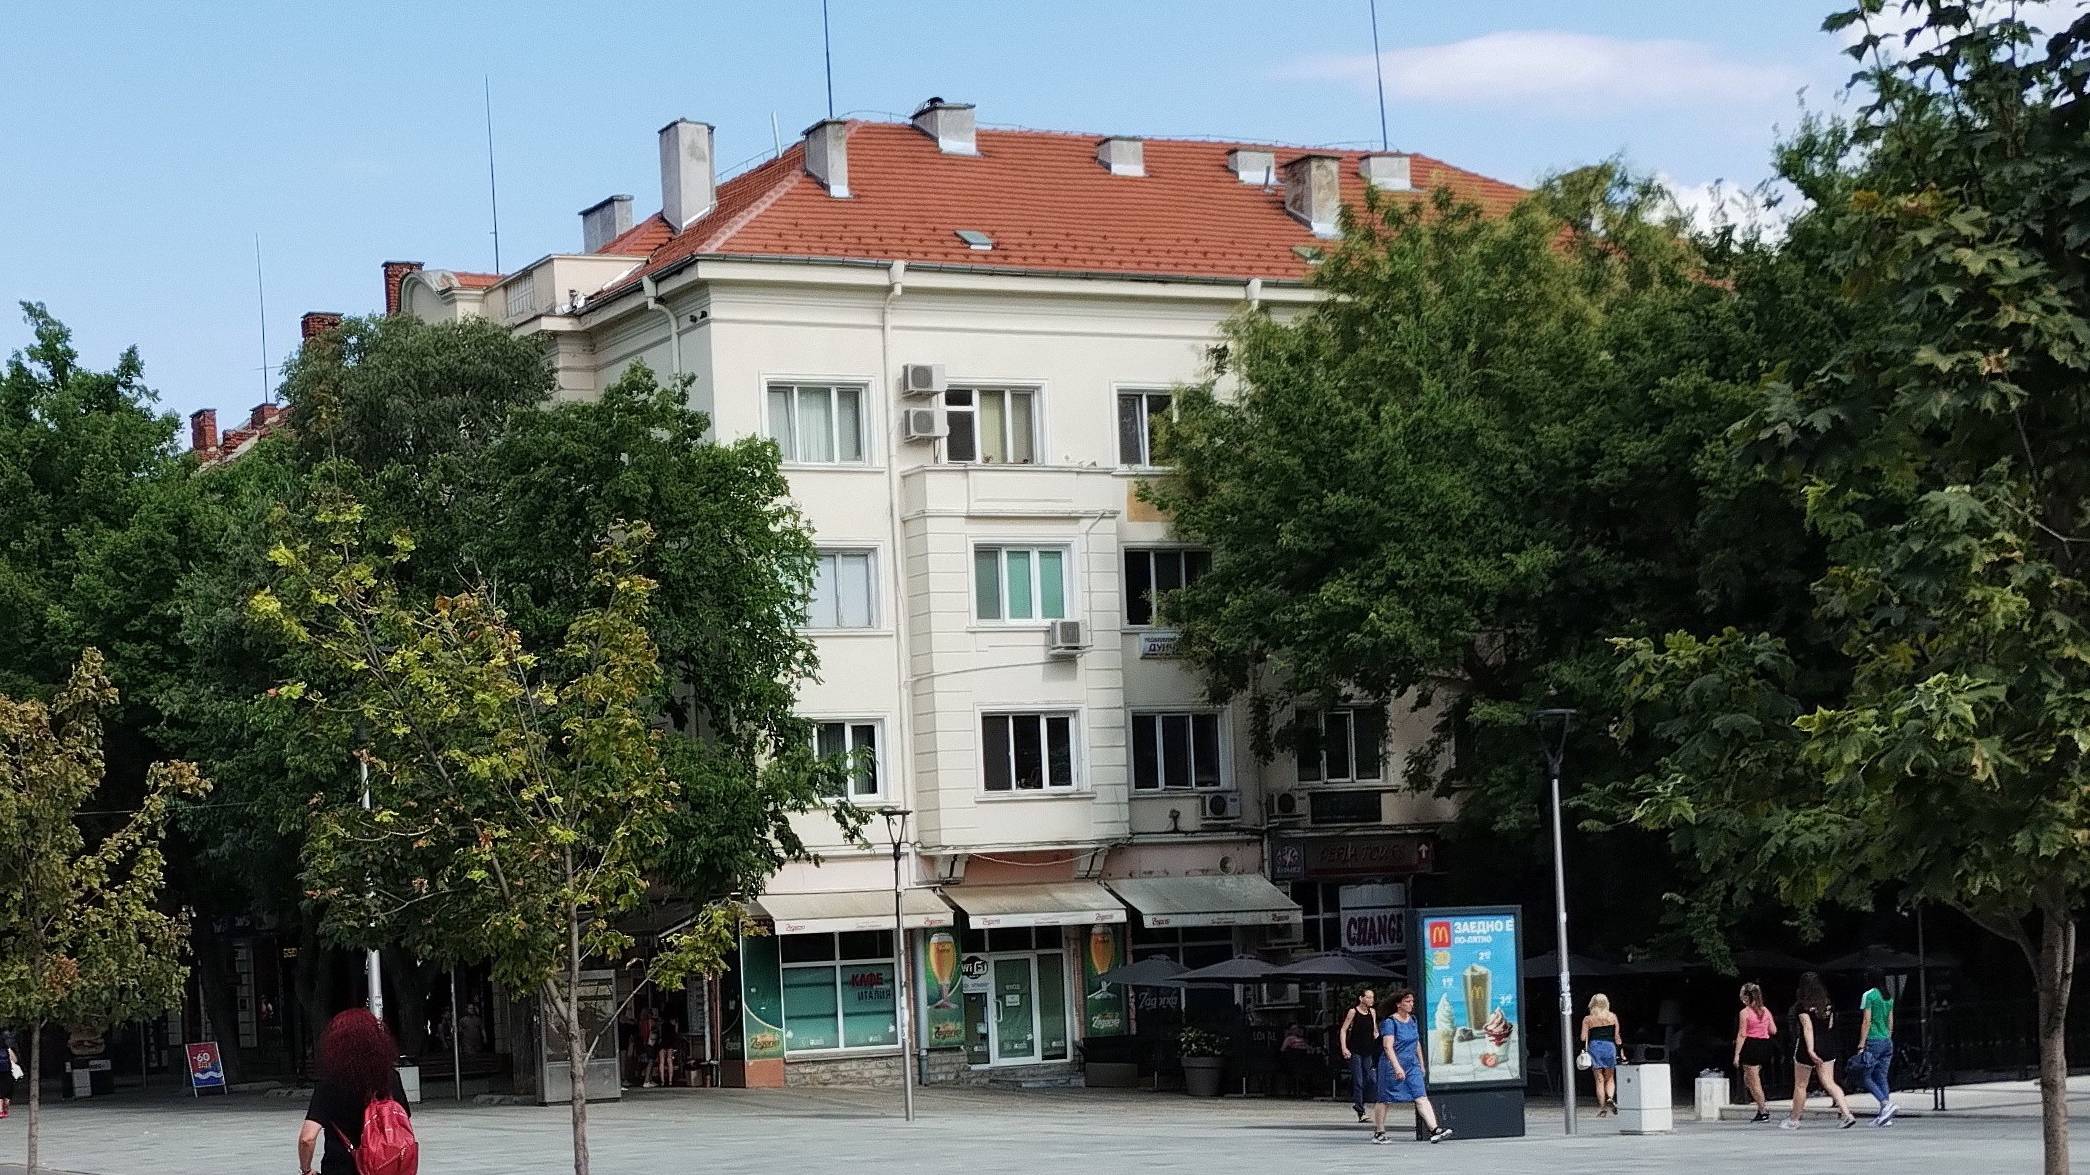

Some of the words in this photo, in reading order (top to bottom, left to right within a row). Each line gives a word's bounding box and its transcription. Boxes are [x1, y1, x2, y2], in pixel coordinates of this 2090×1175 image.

[1347, 913, 1404, 946] CHANGE
[1454, 920, 1504, 934] ЗАЕДНО
[1505, 919, 1514, 932] Е
[857, 990, 891, 1001] ИТАЛИЯ
